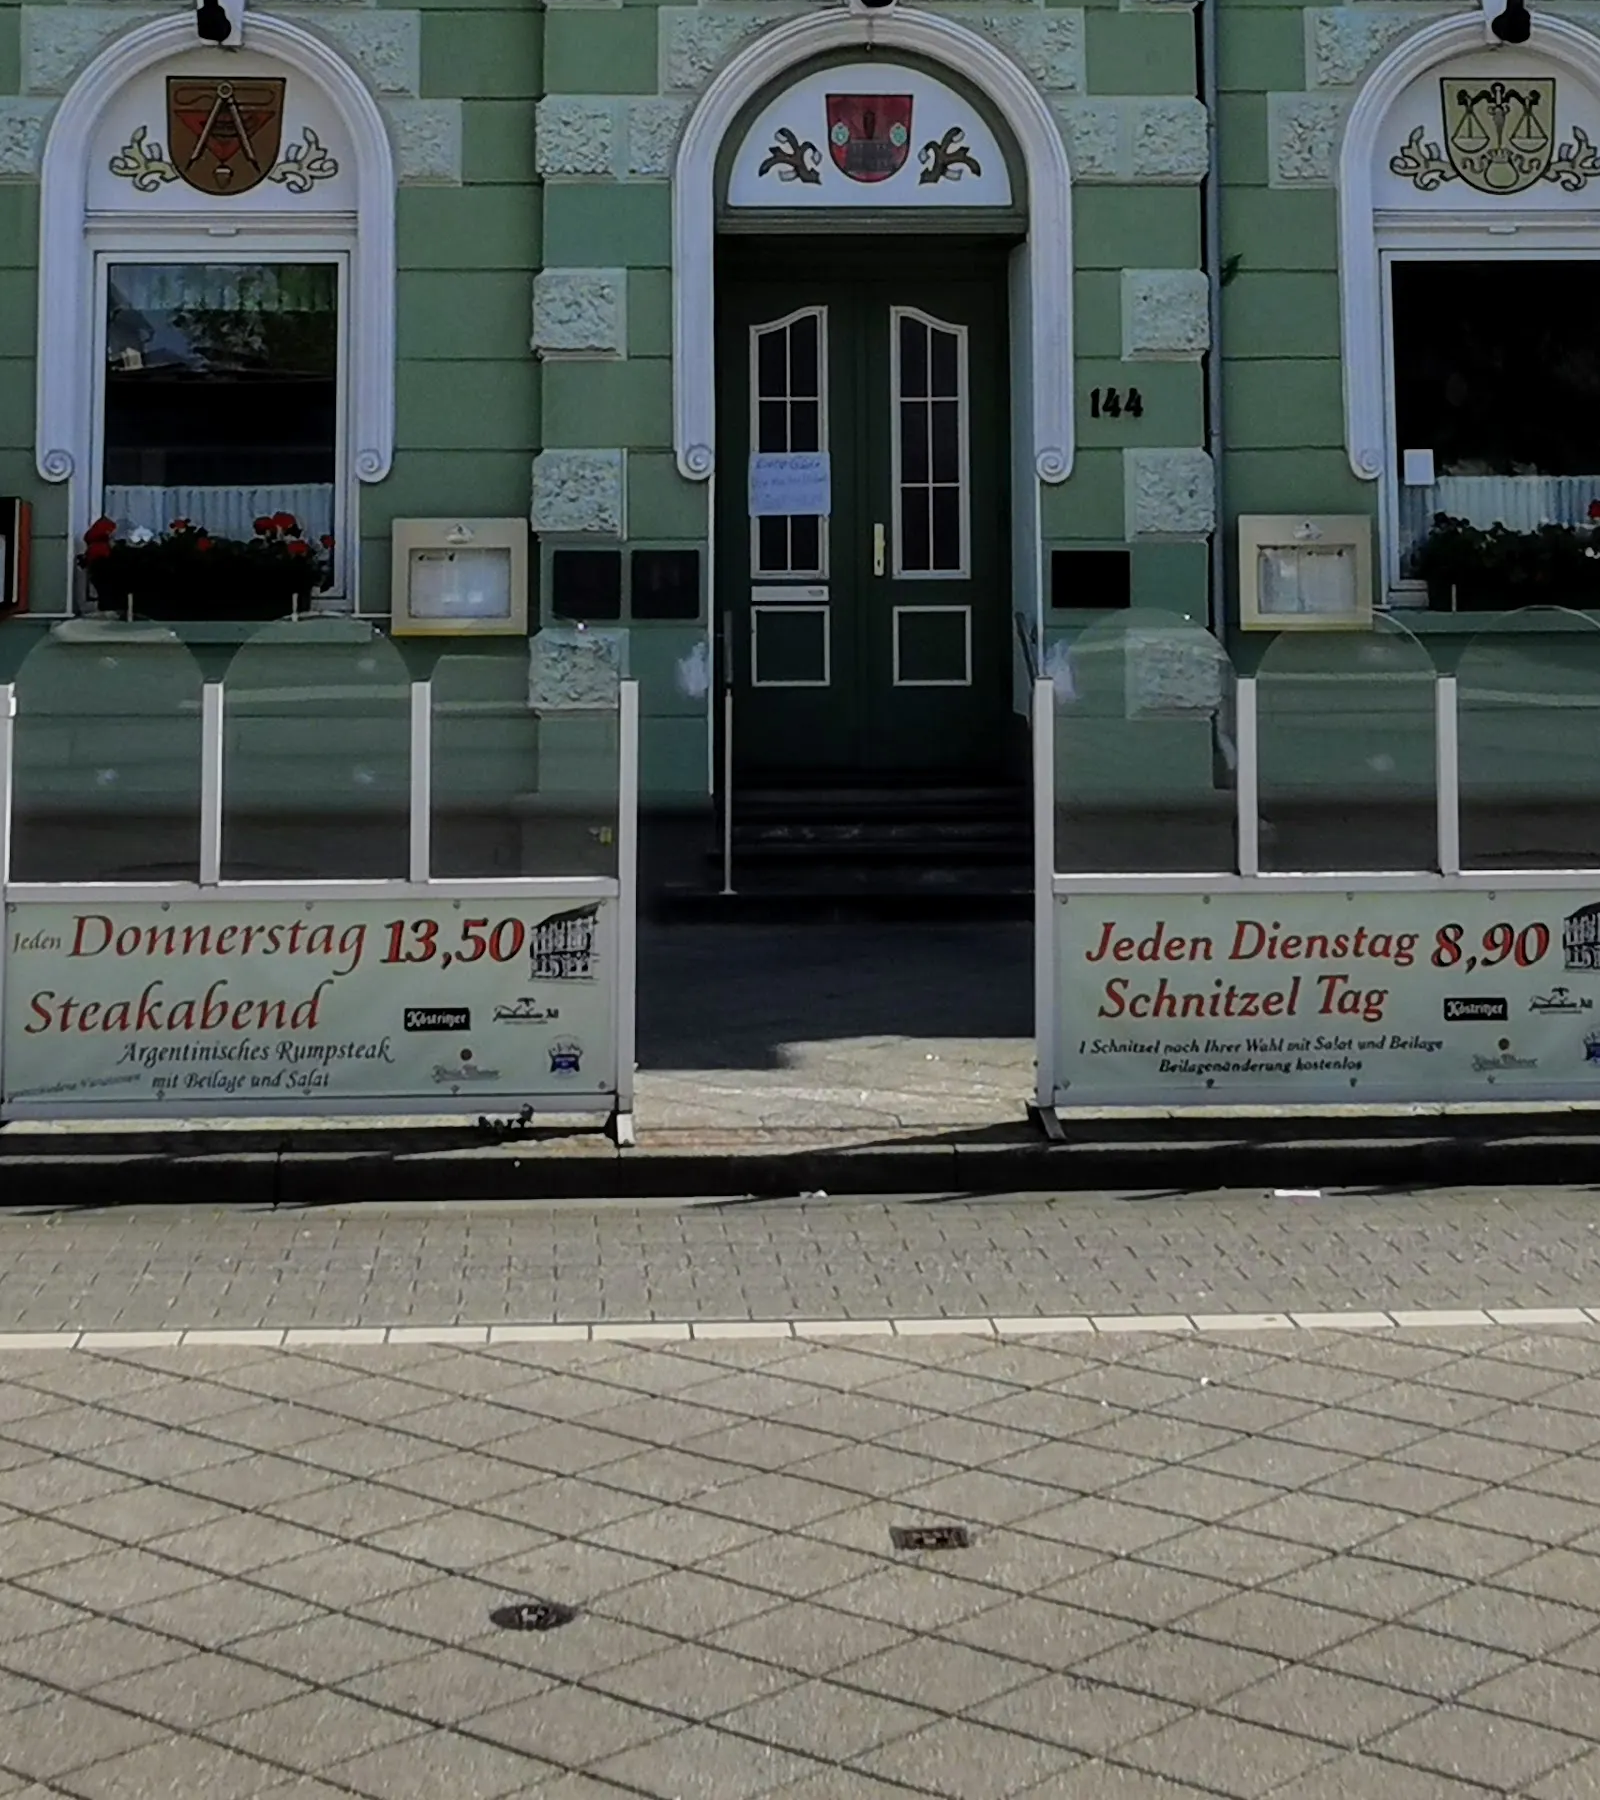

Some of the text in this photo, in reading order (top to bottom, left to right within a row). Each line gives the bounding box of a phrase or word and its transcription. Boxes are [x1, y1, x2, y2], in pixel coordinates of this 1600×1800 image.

[1090, 387, 1144, 418] 144
[12, 915, 526, 977] Jeden Donnerstag 13,50
[1085, 919, 1550, 974] Jeden Dienstag 8,90
[23, 979, 336, 1033] Steakabend
[1097, 974, 1389, 1023] Schnitzel Tag
[116, 1036, 395, 1069] Argentinisches Rumpsteak
[1090, 1039, 1161, 1054] Schnitzel
[1164, 1039, 1199, 1055] nach
[1204, 1039, 1242, 1053] Ihrer
[1245, 1037, 1284, 1052] Wahl
[1287, 1038, 1311, 1051] mit
[1314, 1035, 1353, 1050] Salat
[1357, 1035, 1386, 1049] und
[1389, 1035, 1444, 1052] Beilage
[1296, 1056, 1363, 1071] kostenlos
[151, 1071, 330, 1094] mit Beilage und Salat
